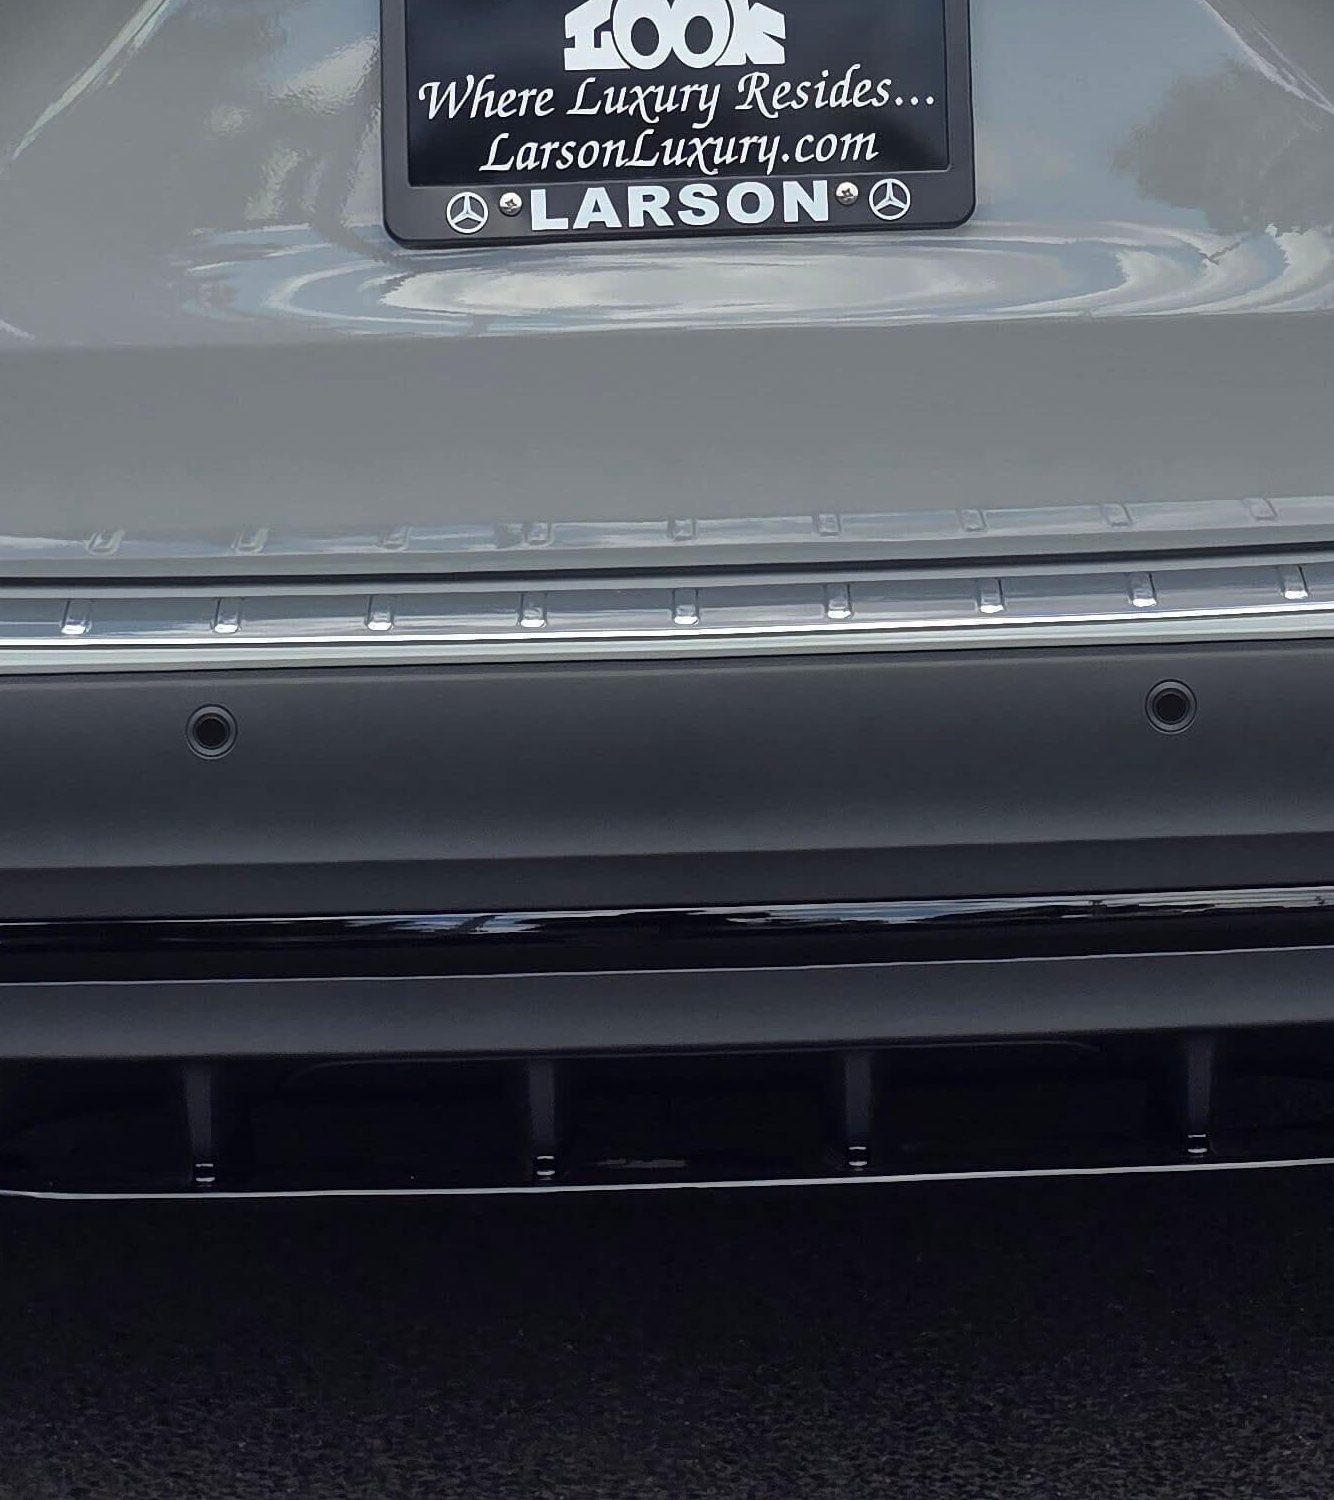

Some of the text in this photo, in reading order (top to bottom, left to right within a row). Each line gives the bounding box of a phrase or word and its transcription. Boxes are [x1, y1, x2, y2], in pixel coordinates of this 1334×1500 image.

[418, 63, 935, 129] Where Luxury Resides...
[478, 127, 880, 175] LarsonLuxury.com
[530, 179, 829, 231] LARSON
